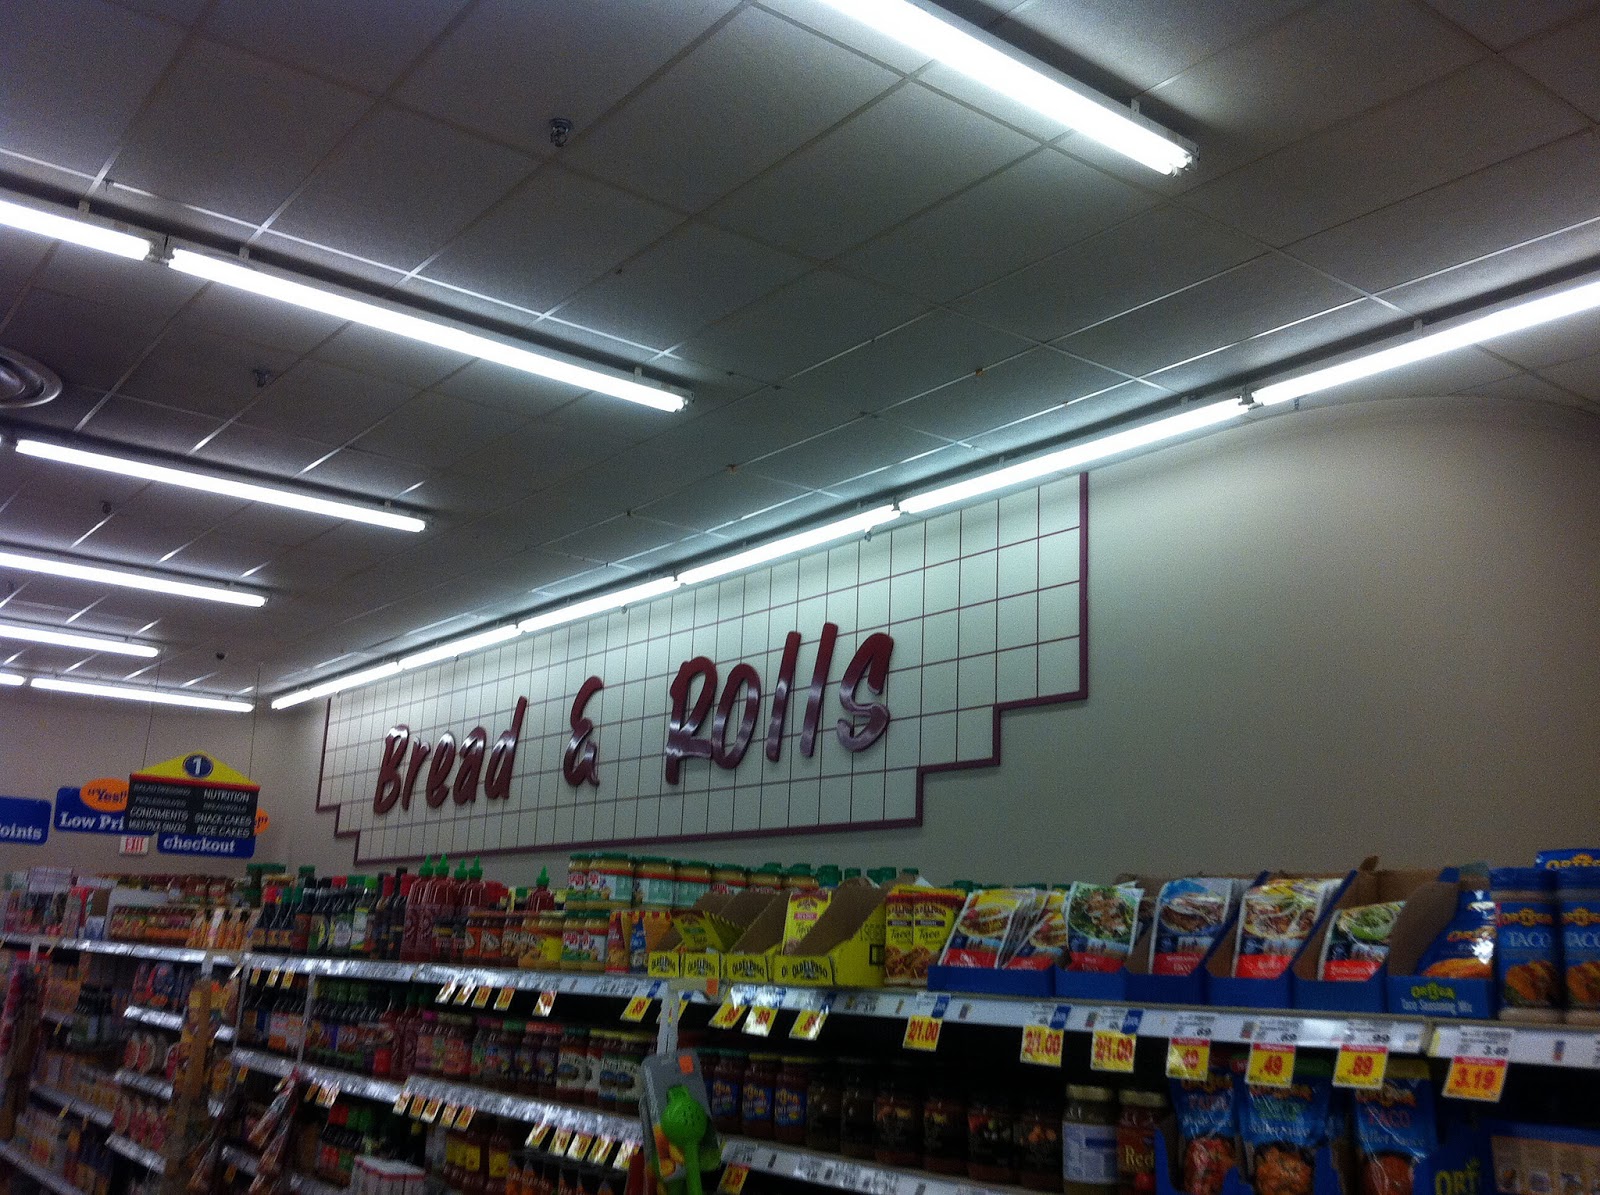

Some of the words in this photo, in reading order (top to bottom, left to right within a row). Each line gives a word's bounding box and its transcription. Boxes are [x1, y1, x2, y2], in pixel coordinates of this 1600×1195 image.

[373, 696, 527, 815] Bread
[563, 676, 604, 787] &
[665, 622, 894, 785] Rolls
[193, 757, 202, 775] 1
[203, 788, 250, 803] NUTRITION
[59, 811, 96, 829] Low
[98, 814, 125, 831] Pri
[130, 806, 189, 822] CONDIMENTS
[224, 815, 252, 827] CAKES
[196, 824, 218, 836] RICE
[219, 826, 251, 839] CAKES
[163, 834, 236, 853] checkout
